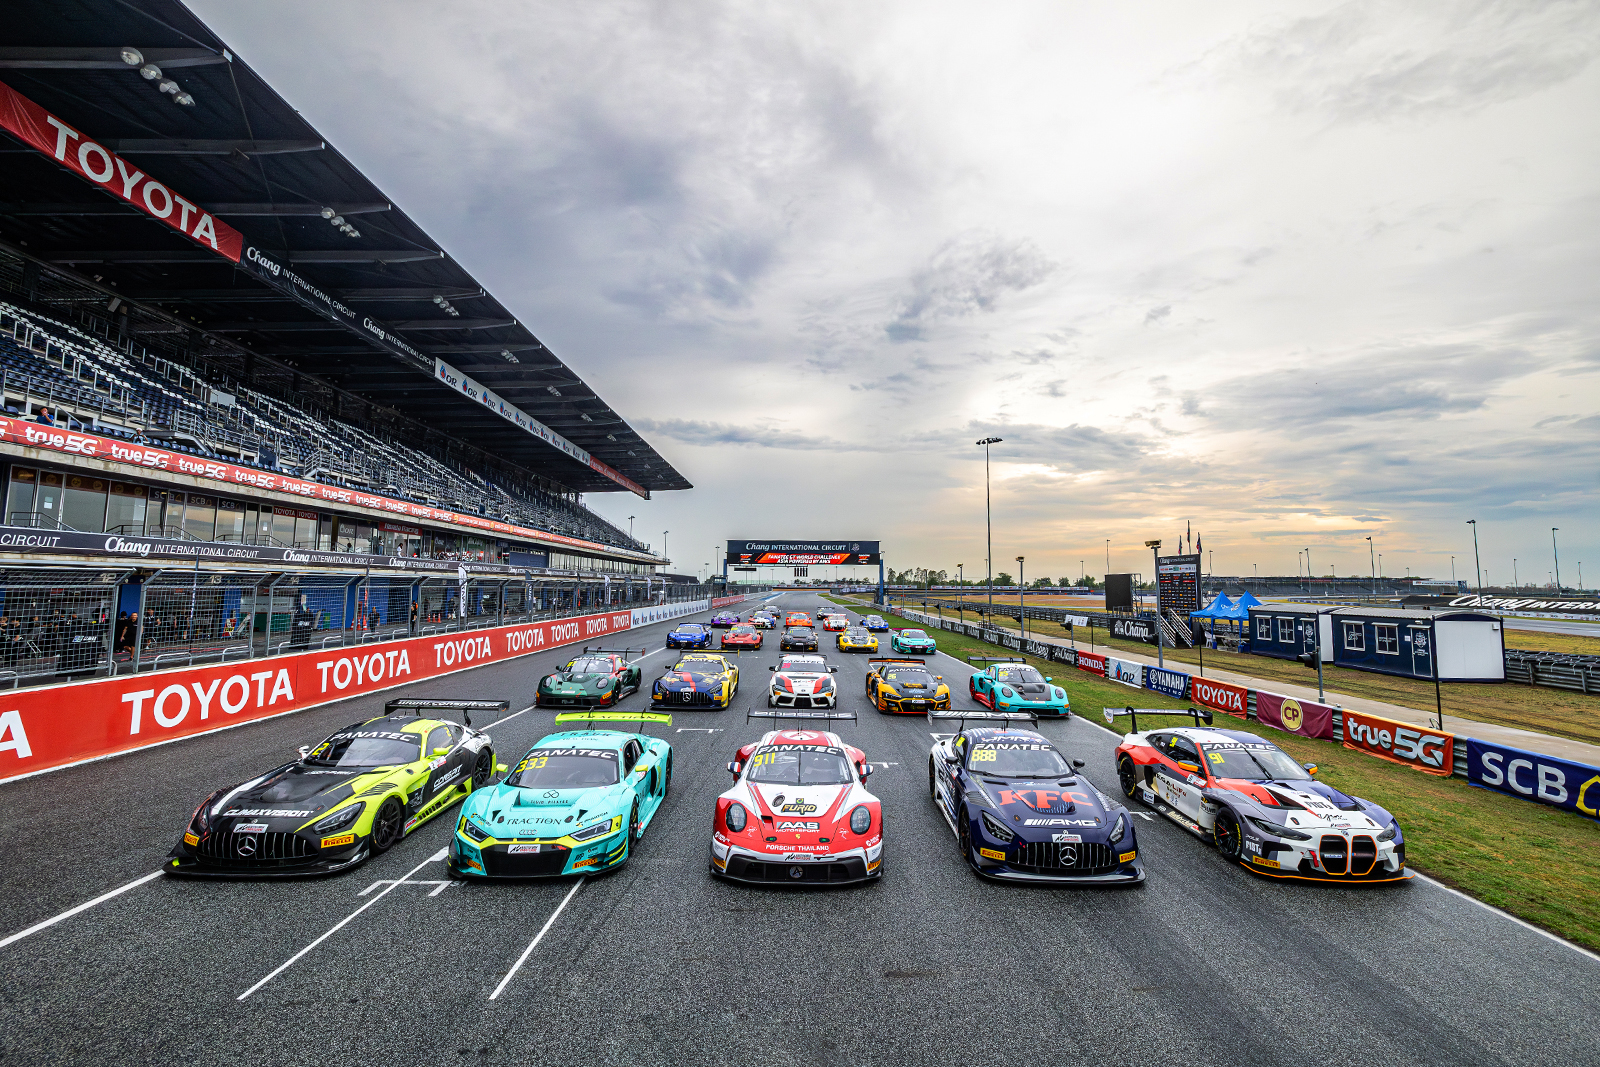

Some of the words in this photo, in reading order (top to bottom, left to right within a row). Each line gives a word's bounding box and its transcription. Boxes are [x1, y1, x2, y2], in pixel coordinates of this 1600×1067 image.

[47, 115, 218, 250] TOYOTA
[247, 247, 281, 276] Chang
[283, 268, 332, 304] INTERNATIONAL
[332, 300, 357, 320] CIRCUIT
[363, 317, 385, 340] Chang
[446, 375, 457, 388] OR
[467, 387, 478, 399] OR
[487, 399, 496, 410] OR
[25, 426, 98, 454] true5G
[111, 443, 170, 468] true5G
[178, 457, 228, 479] true5G
[235, 470, 275, 488] true5G
[282, 480, 317, 496] true5G
[322, 487, 352, 503] true5G
[191, 497, 206, 505] SCB
[221, 501, 235, 509] SCB
[355, 494, 381, 508] true5G
[274, 507, 296, 517] TOYOTA
[298, 512, 318, 521] TOYOTA
[0, 534, 60, 548] CIRCUIT
[105, 536, 151, 557] Chang
[154, 544, 226, 556] INTERNATIONAL
[227, 548, 259, 558] CIRCUIT
[746, 542, 769, 551] Chang
[283, 550, 311, 565] Chang
[311, 554, 353, 564] INTERNATIONAL
[354, 557, 374, 565] CIRCUIT
[389, 557, 407, 570] Chang
[407, 560, 435, 568] INTERNATIONAL
[101, 573, 116, 583] 12
[210, 575, 222, 583] 13
[1449, 594, 1538, 610] Chang
[586, 617, 608, 634] TOYOTA
[613, 614, 629, 628] TOYOTA
[551, 622, 579, 641] TOYOTA
[1124, 620, 1149, 643] Chang
[506, 628, 544, 653] TOYOTA
[434, 636, 492, 668] TOYOTA
[1033, 640, 1048, 660] Chang
[1060, 647, 1075, 664] Chang
[317, 649, 411, 693] TOYOTA
[1079, 657, 1105, 671] HONDA
[1122, 671, 1134, 683] OR
[1157, 671, 1185, 691] YAMAHA
[1152, 684, 1182, 696] RACING
[1196, 683, 1243, 711] TOYOTA
[121, 668, 294, 735] TOYOTA
[1284, 707, 1299, 721] CP
[328, 732, 418, 742] FANATEC
[444, 726, 452, 737] 2
[974, 743, 1052, 751] FANATEC
[1202, 743, 1276, 751] FANATEC
[1347, 717, 1445, 766] true5G
[312, 742, 329, 756] 2
[527, 748, 618, 759] FANATEC
[757, 744, 842, 754] FANATEC
[972, 750, 996, 762] 888
[754, 752, 775, 767] 911
[1208, 752, 1226, 764] 91
[516, 757, 548, 774] 333
[1481, 751, 1568, 803] SCB
[998, 790, 1094, 809] KFC
[222, 808, 314, 817] CLIMAXVISION
[782, 804, 816, 814] FURIO
[780, 822, 819, 830] AAS
[323, 836, 352, 847] PIRELLI
[766, 844, 795, 852] PORSCHE
[982, 850, 1004, 859] PIRELLI
[576, 858, 598, 869] PIRELLI
[1254, 857, 1279, 868] PIRELLI
